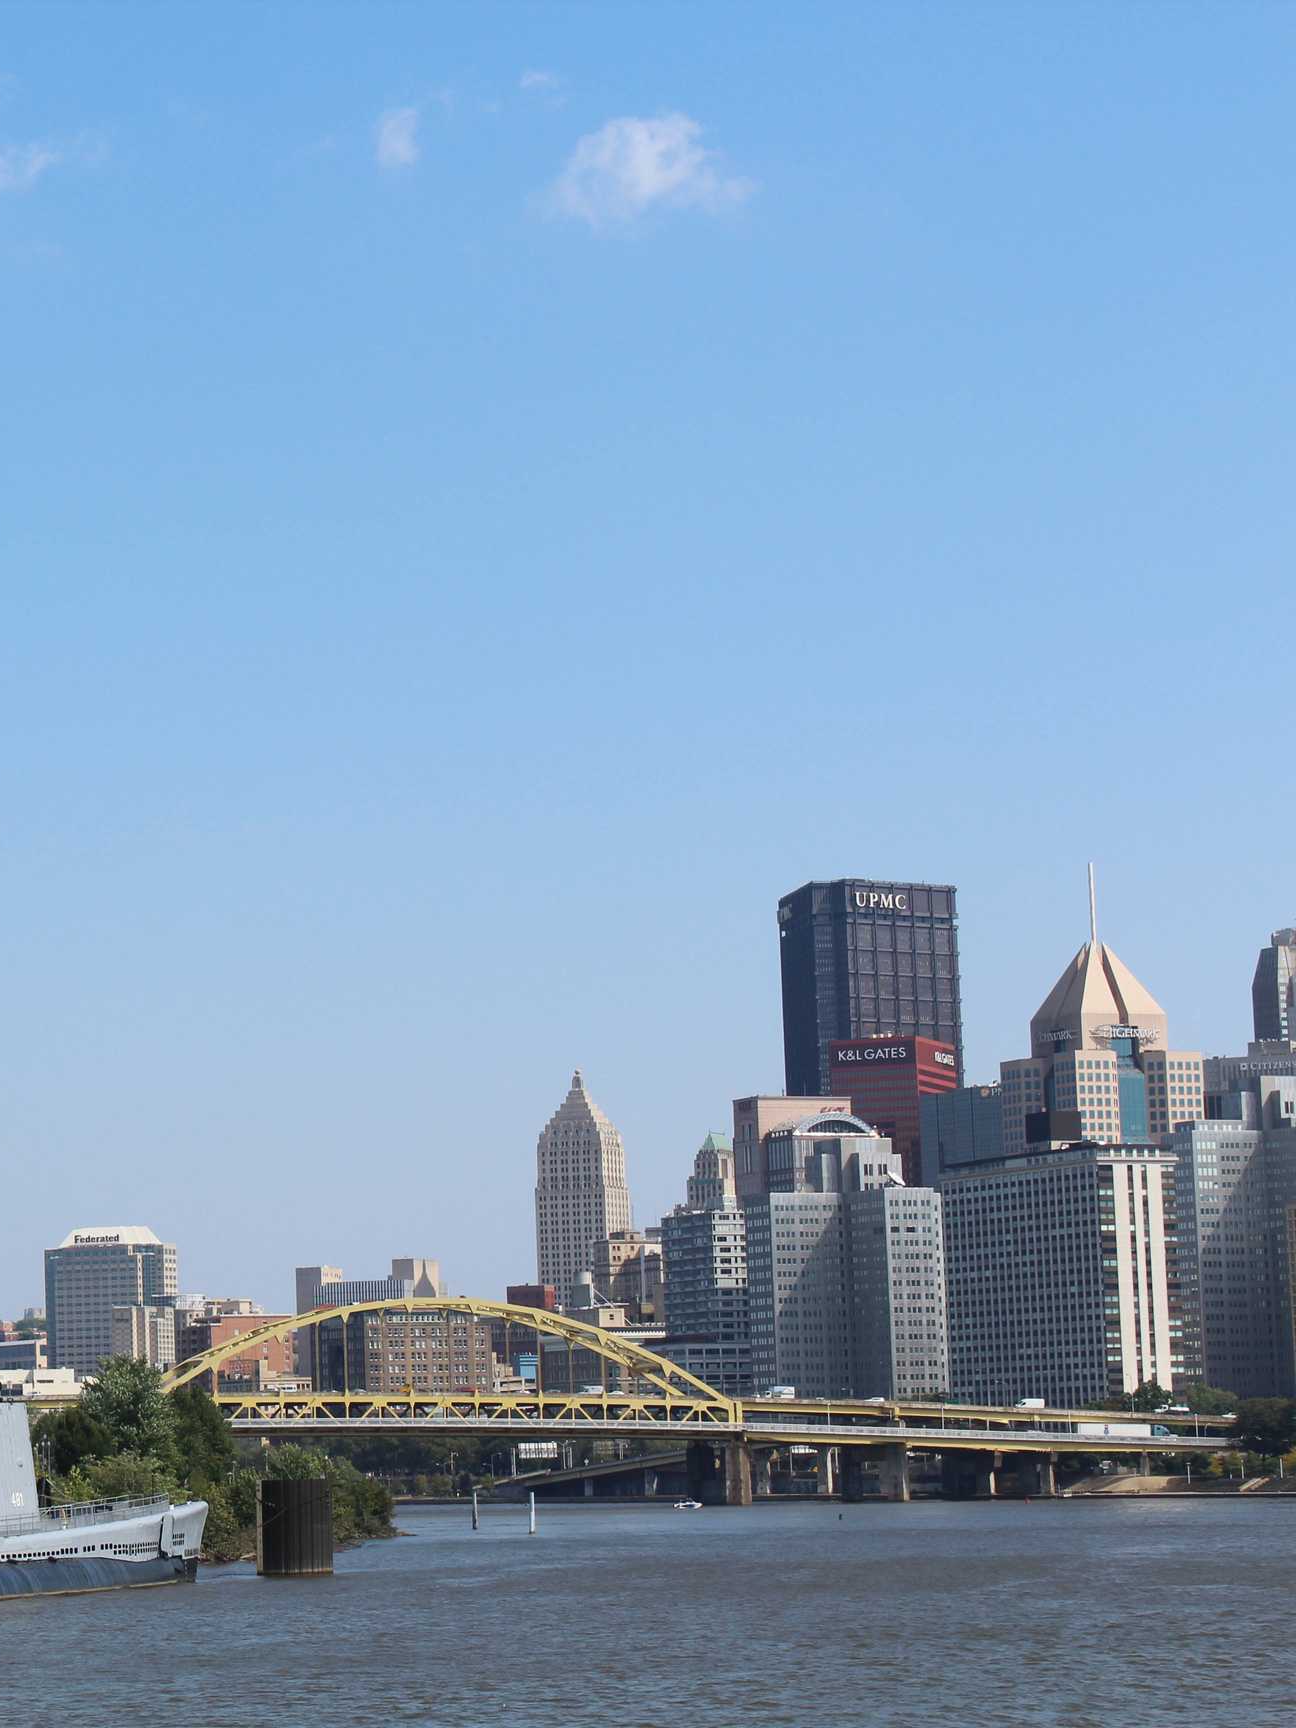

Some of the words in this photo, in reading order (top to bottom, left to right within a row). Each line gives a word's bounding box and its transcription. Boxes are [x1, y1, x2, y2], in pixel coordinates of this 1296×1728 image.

[855, 891, 907, 910] UPMC
[837, 1050, 862, 1061] K&L
[864, 1047, 906, 1060] GATES
[73, 1233, 120, 1244] Federated
